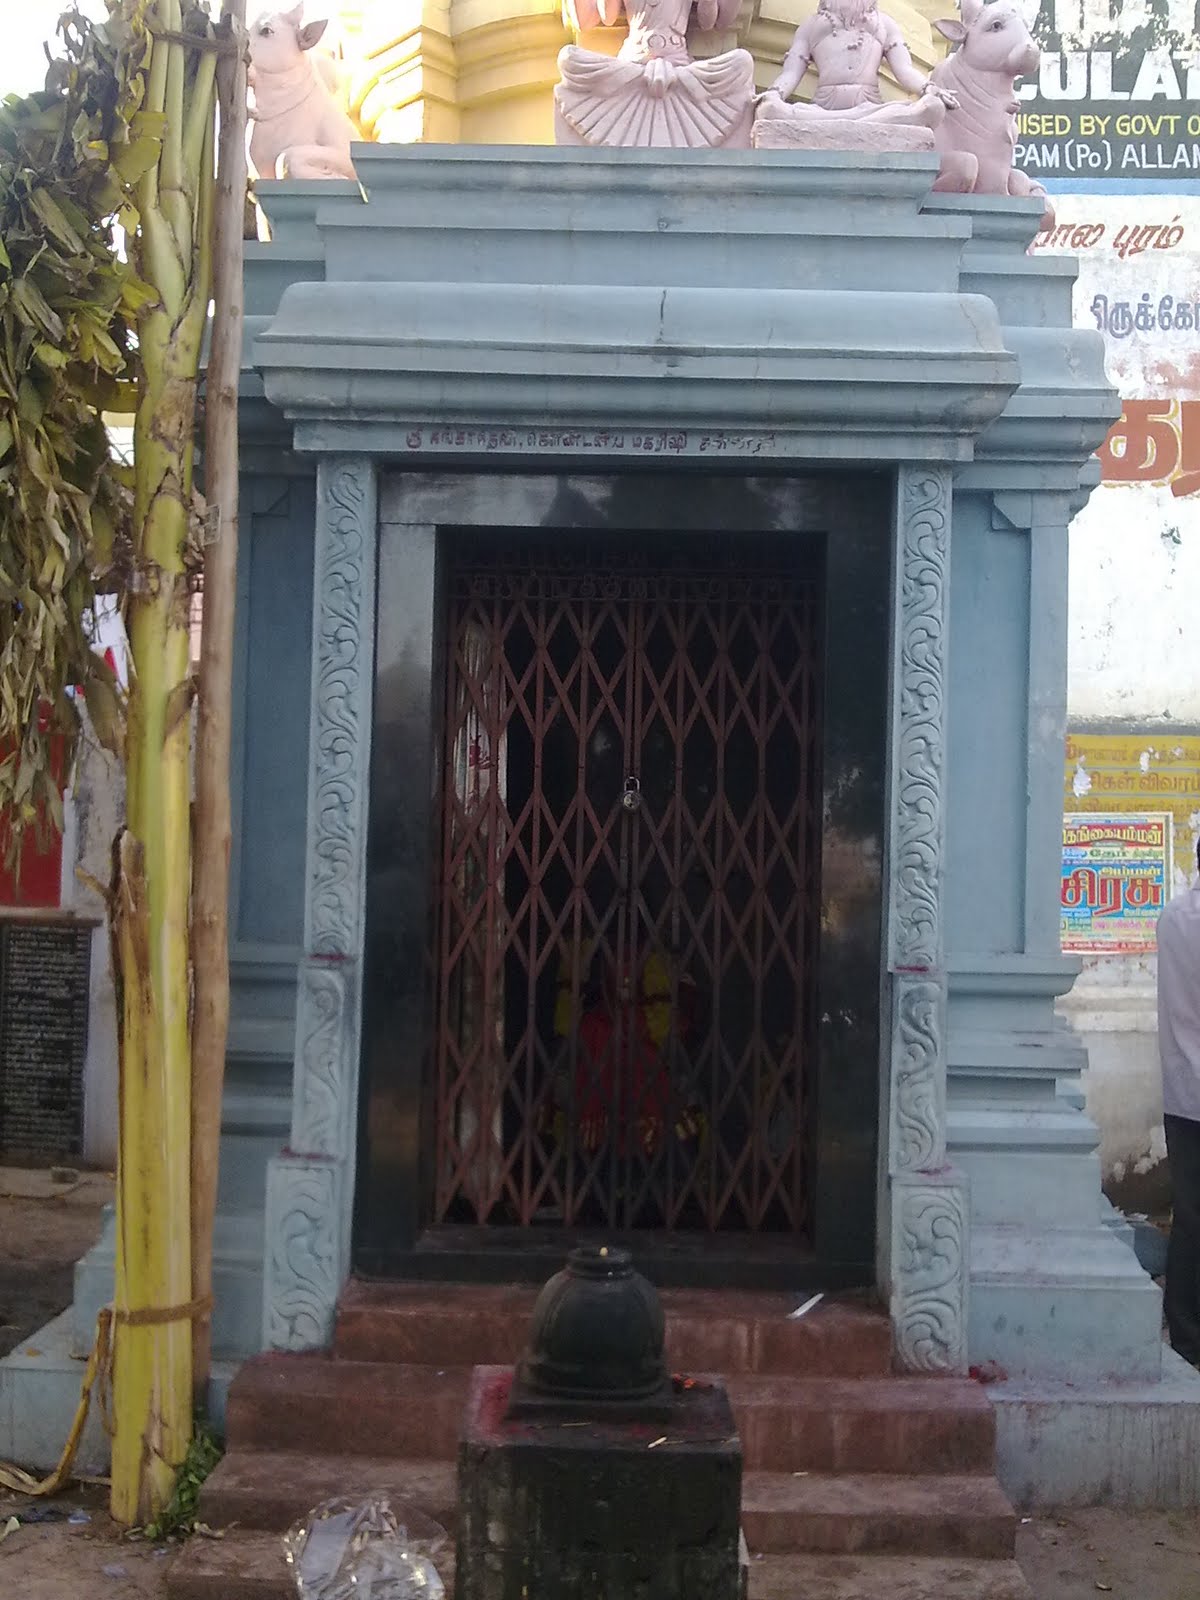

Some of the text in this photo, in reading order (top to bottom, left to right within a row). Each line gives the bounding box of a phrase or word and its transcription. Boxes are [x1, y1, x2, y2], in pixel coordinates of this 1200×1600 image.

[1080, 114, 1111, 136] BY
[1116, 114, 1181, 136] GOVT
[1113, 215, 1184, 259] புரம்
[1061, 866, 1162, 917] சிரசு
